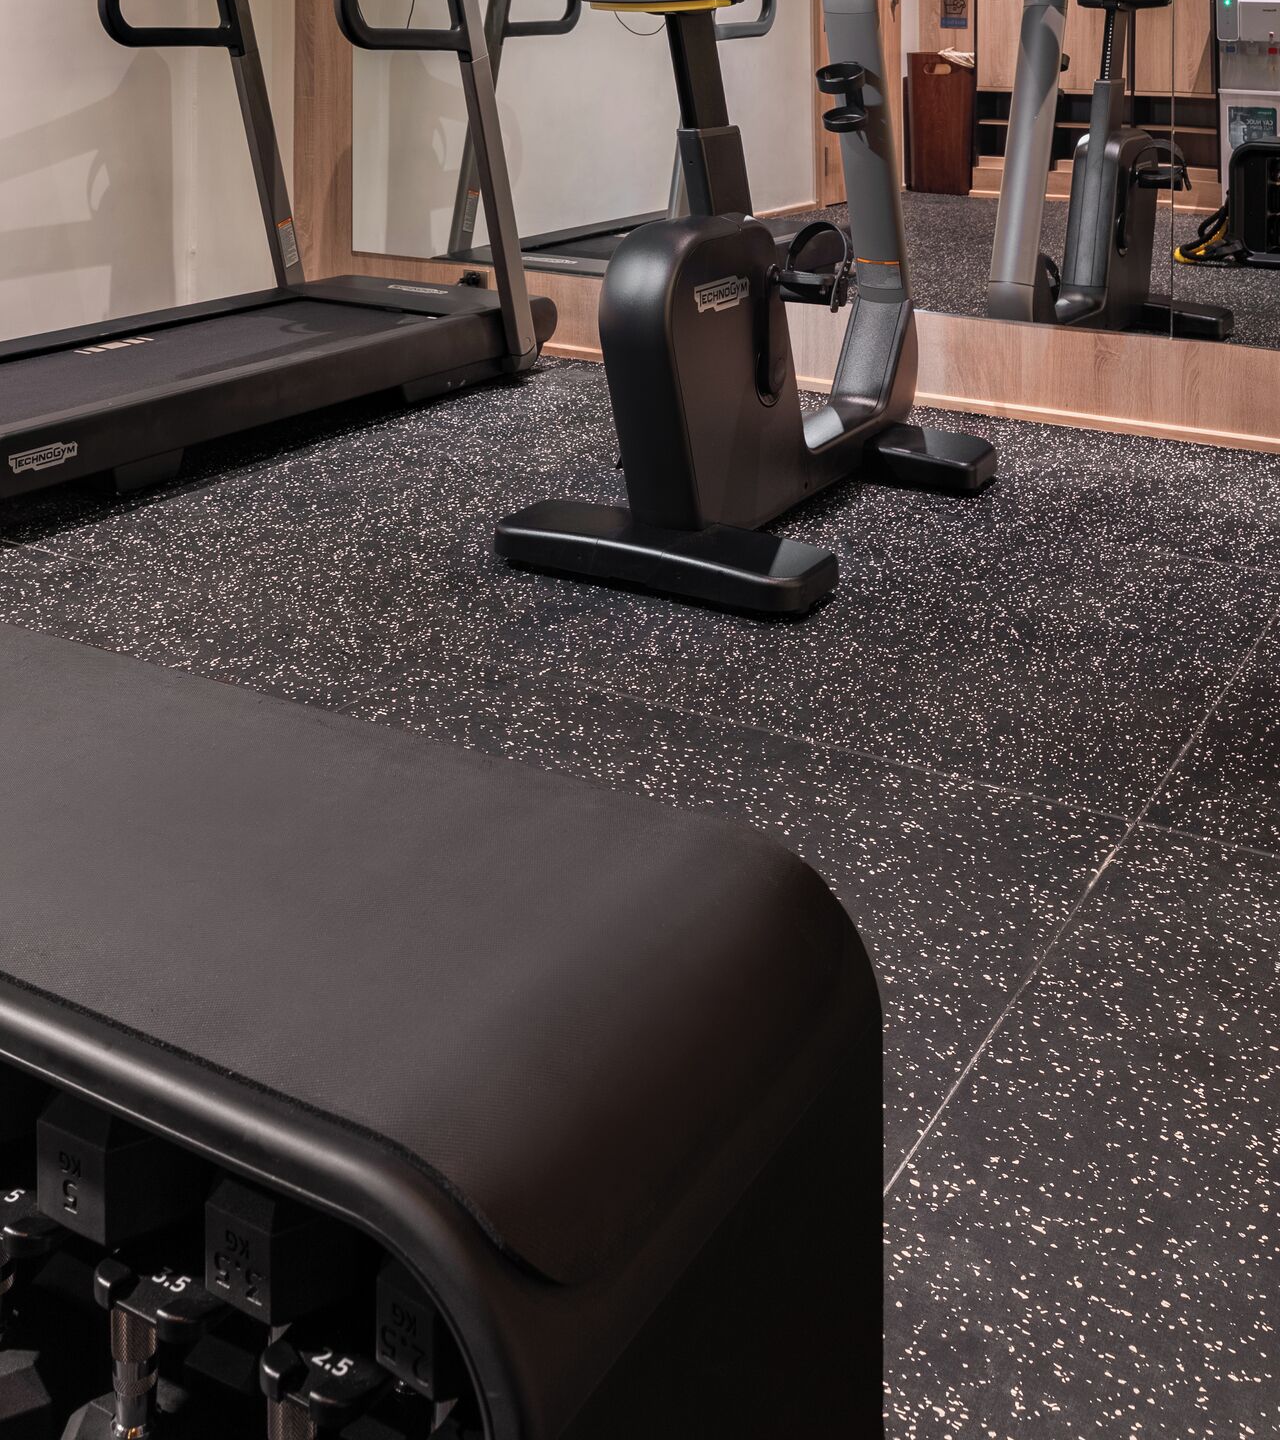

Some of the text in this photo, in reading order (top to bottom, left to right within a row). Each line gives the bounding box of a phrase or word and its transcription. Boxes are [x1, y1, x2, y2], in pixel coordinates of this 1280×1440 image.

[3, 1187, 26, 1203] 5
[62, 1178, 78, 1216] 5
[311, 1346, 355, 1377] 2.5
